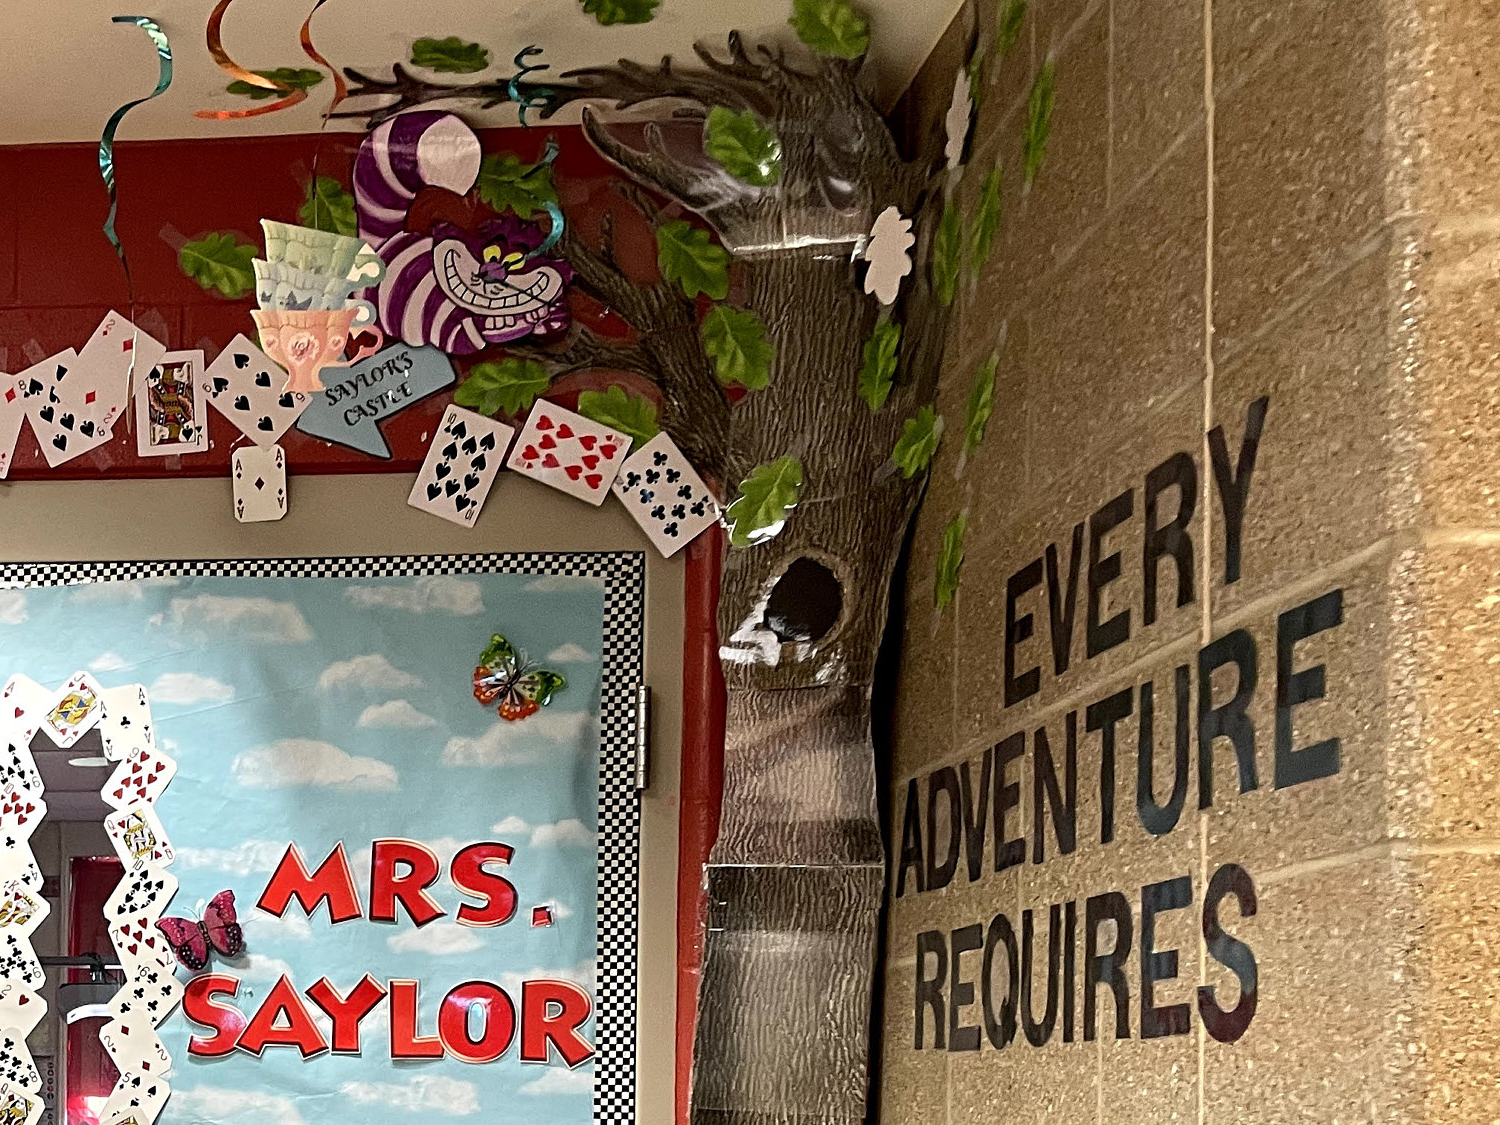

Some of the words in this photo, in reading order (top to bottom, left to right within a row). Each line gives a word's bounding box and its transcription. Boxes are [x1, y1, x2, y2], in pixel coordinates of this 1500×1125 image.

[325, 352, 413, 406] SAYLOR'S
[344, 382, 412, 426] CASTLE
[1004, 396, 1269, 708] EVERY
[896, 588, 1345, 899] ADVENTURE
[255, 838, 554, 928] MRS.
[914, 862, 1258, 1052] REQUIRES
[181, 973, 596, 1070] SAYLOR
